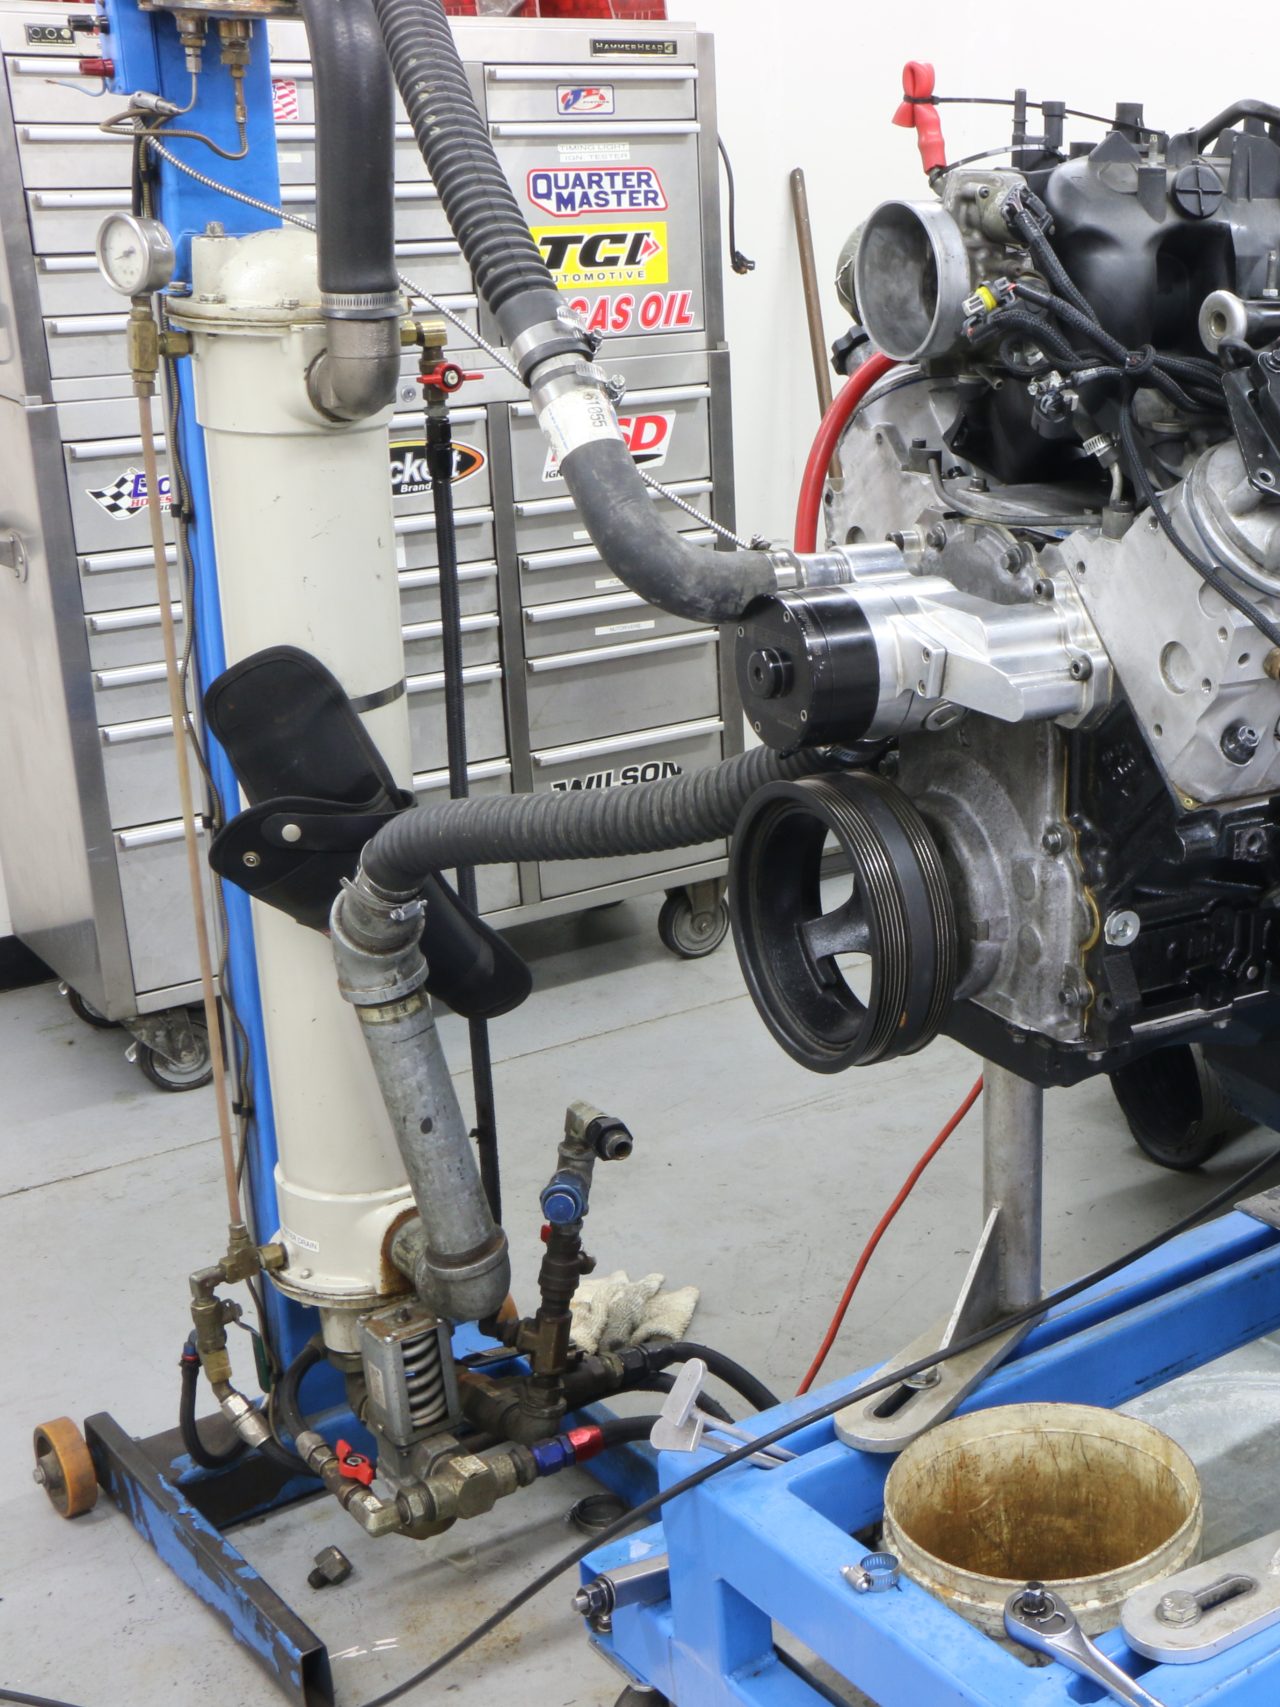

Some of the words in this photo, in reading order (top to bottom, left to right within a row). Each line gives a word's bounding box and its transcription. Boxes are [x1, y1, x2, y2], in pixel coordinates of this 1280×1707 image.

[532, 171, 653, 200] QUARTER
[555, 190, 660, 212] MASTER
[539, 232, 651, 271] TCI
[550, 270, 645, 284] UTOMOTIVE
[640, 293, 693, 329] OIL
[617, 414, 668, 452] SD
[400, 482, 432, 493] Brand
[552, 761, 682, 792] WILSON
